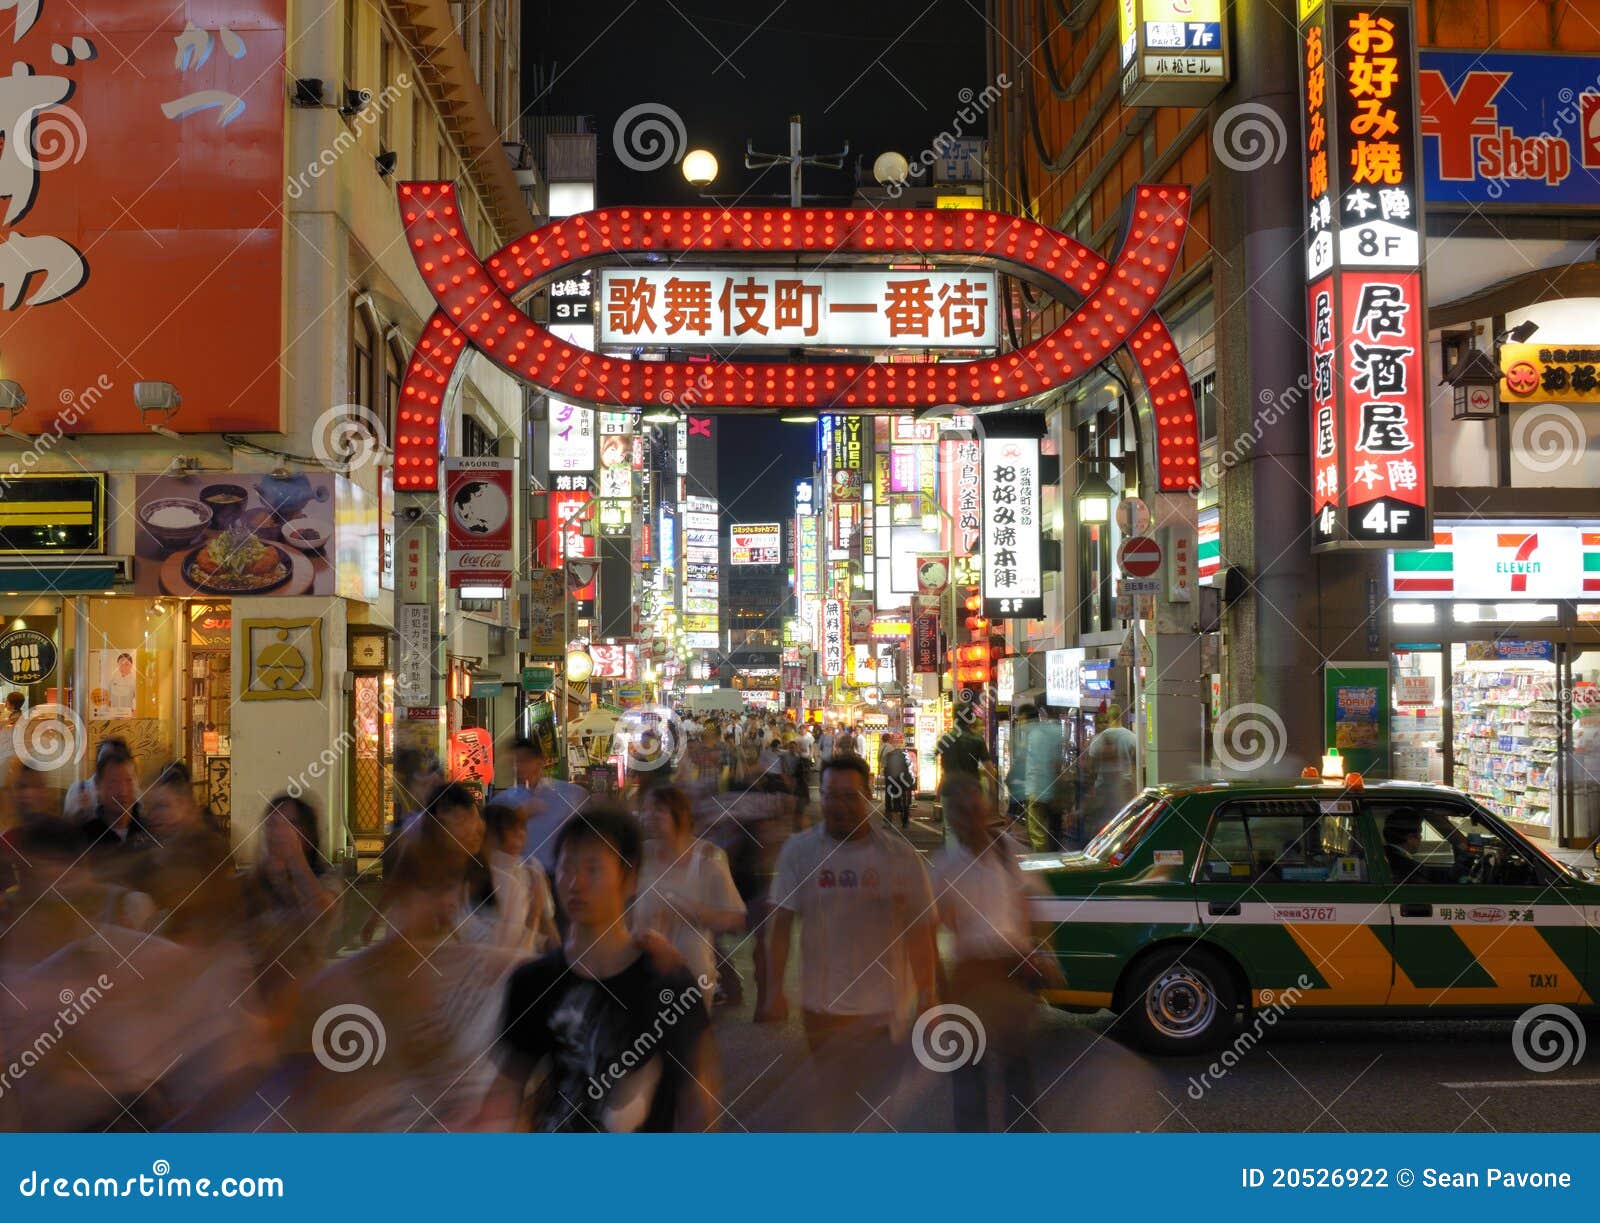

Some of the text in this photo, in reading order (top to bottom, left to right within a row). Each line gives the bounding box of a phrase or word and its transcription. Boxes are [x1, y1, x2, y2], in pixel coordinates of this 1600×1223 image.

[1189, 23, 1213, 46] 7F
[1156, 58, 1211, 74] 小松ビル
[1307, 26, 1328, 200] お好み焼
[1348, 12, 1403, 185] お好み焼
[1477, 126, 1571, 186] shop
[1346, 188, 1410, 219] 本陣
[1315, 241, 1327, 266] 8F
[1358, 228, 1401, 257] 8F
[556, 303, 587, 318] 3F
[608, 276, 988, 339] 歌舞伎町一番街
[1314, 291, 1335, 458] 居酒屋
[1350, 284, 1414, 453] 居酒屋
[556, 405, 575, 441] タイ
[606, 424, 625, 433] B1
[556, 475, 587, 490] 焼肉
[1354, 461, 1417, 491] 本陣
[992, 465, 1018, 588] お好み焼本陣
[1320, 507, 1335, 534] 4F
[1362, 502, 1410, 533] 4F
[1496, 561, 1541, 573] ELEVEN
[999, 598, 1024, 612] 2F
[826, 603, 840, 672] 無料案内所
[1303, 908, 1334, 920] 3767
[1440, 908, 1466, 921] 明治
[1508, 909, 1534, 922] 交通
[1529, 974, 1558, 987] TAXI
